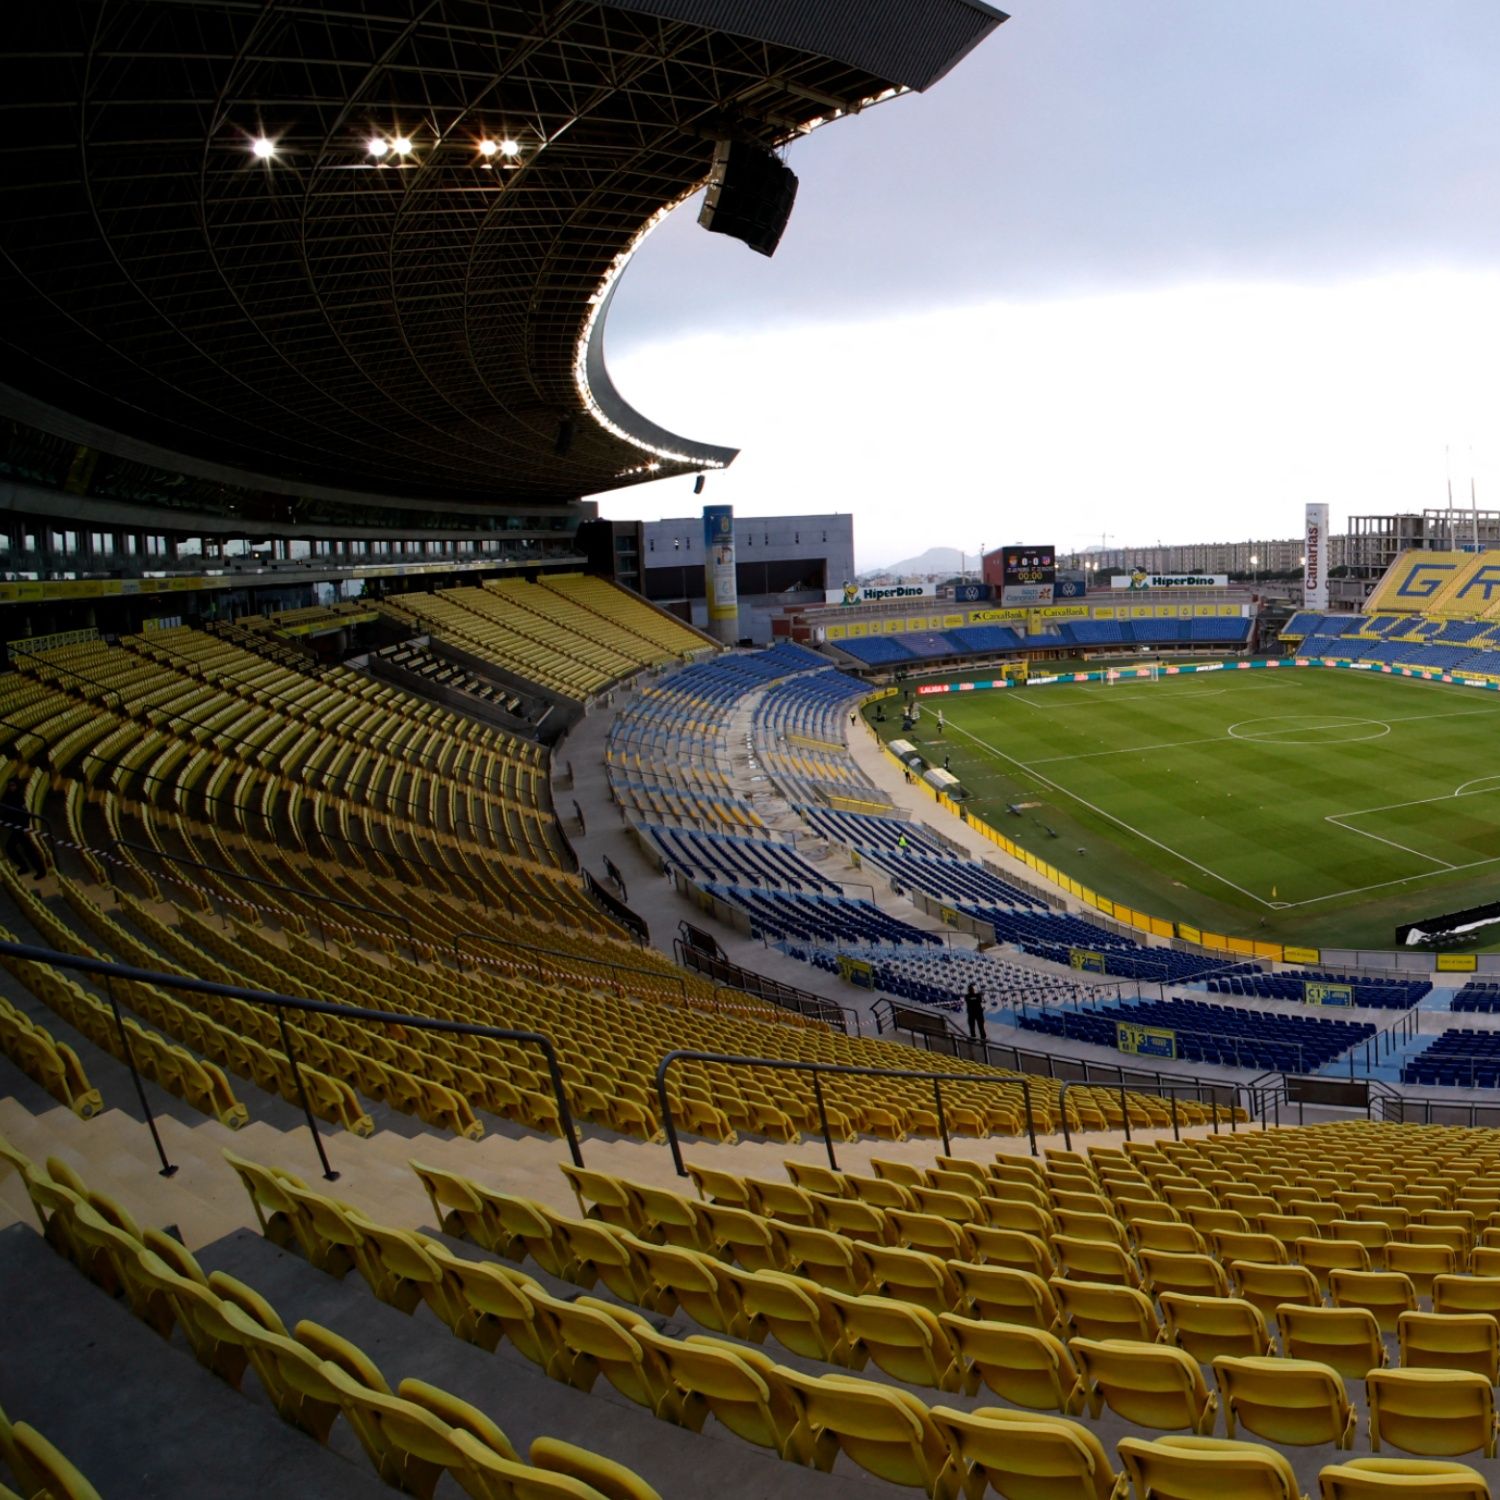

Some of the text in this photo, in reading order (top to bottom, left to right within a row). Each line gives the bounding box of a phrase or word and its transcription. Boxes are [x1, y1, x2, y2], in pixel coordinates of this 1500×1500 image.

[1152, 576, 1216, 588] HiperDino
[863, 587, 924, 600] HiperDino
[1119, 1030, 1146, 1045] B13
